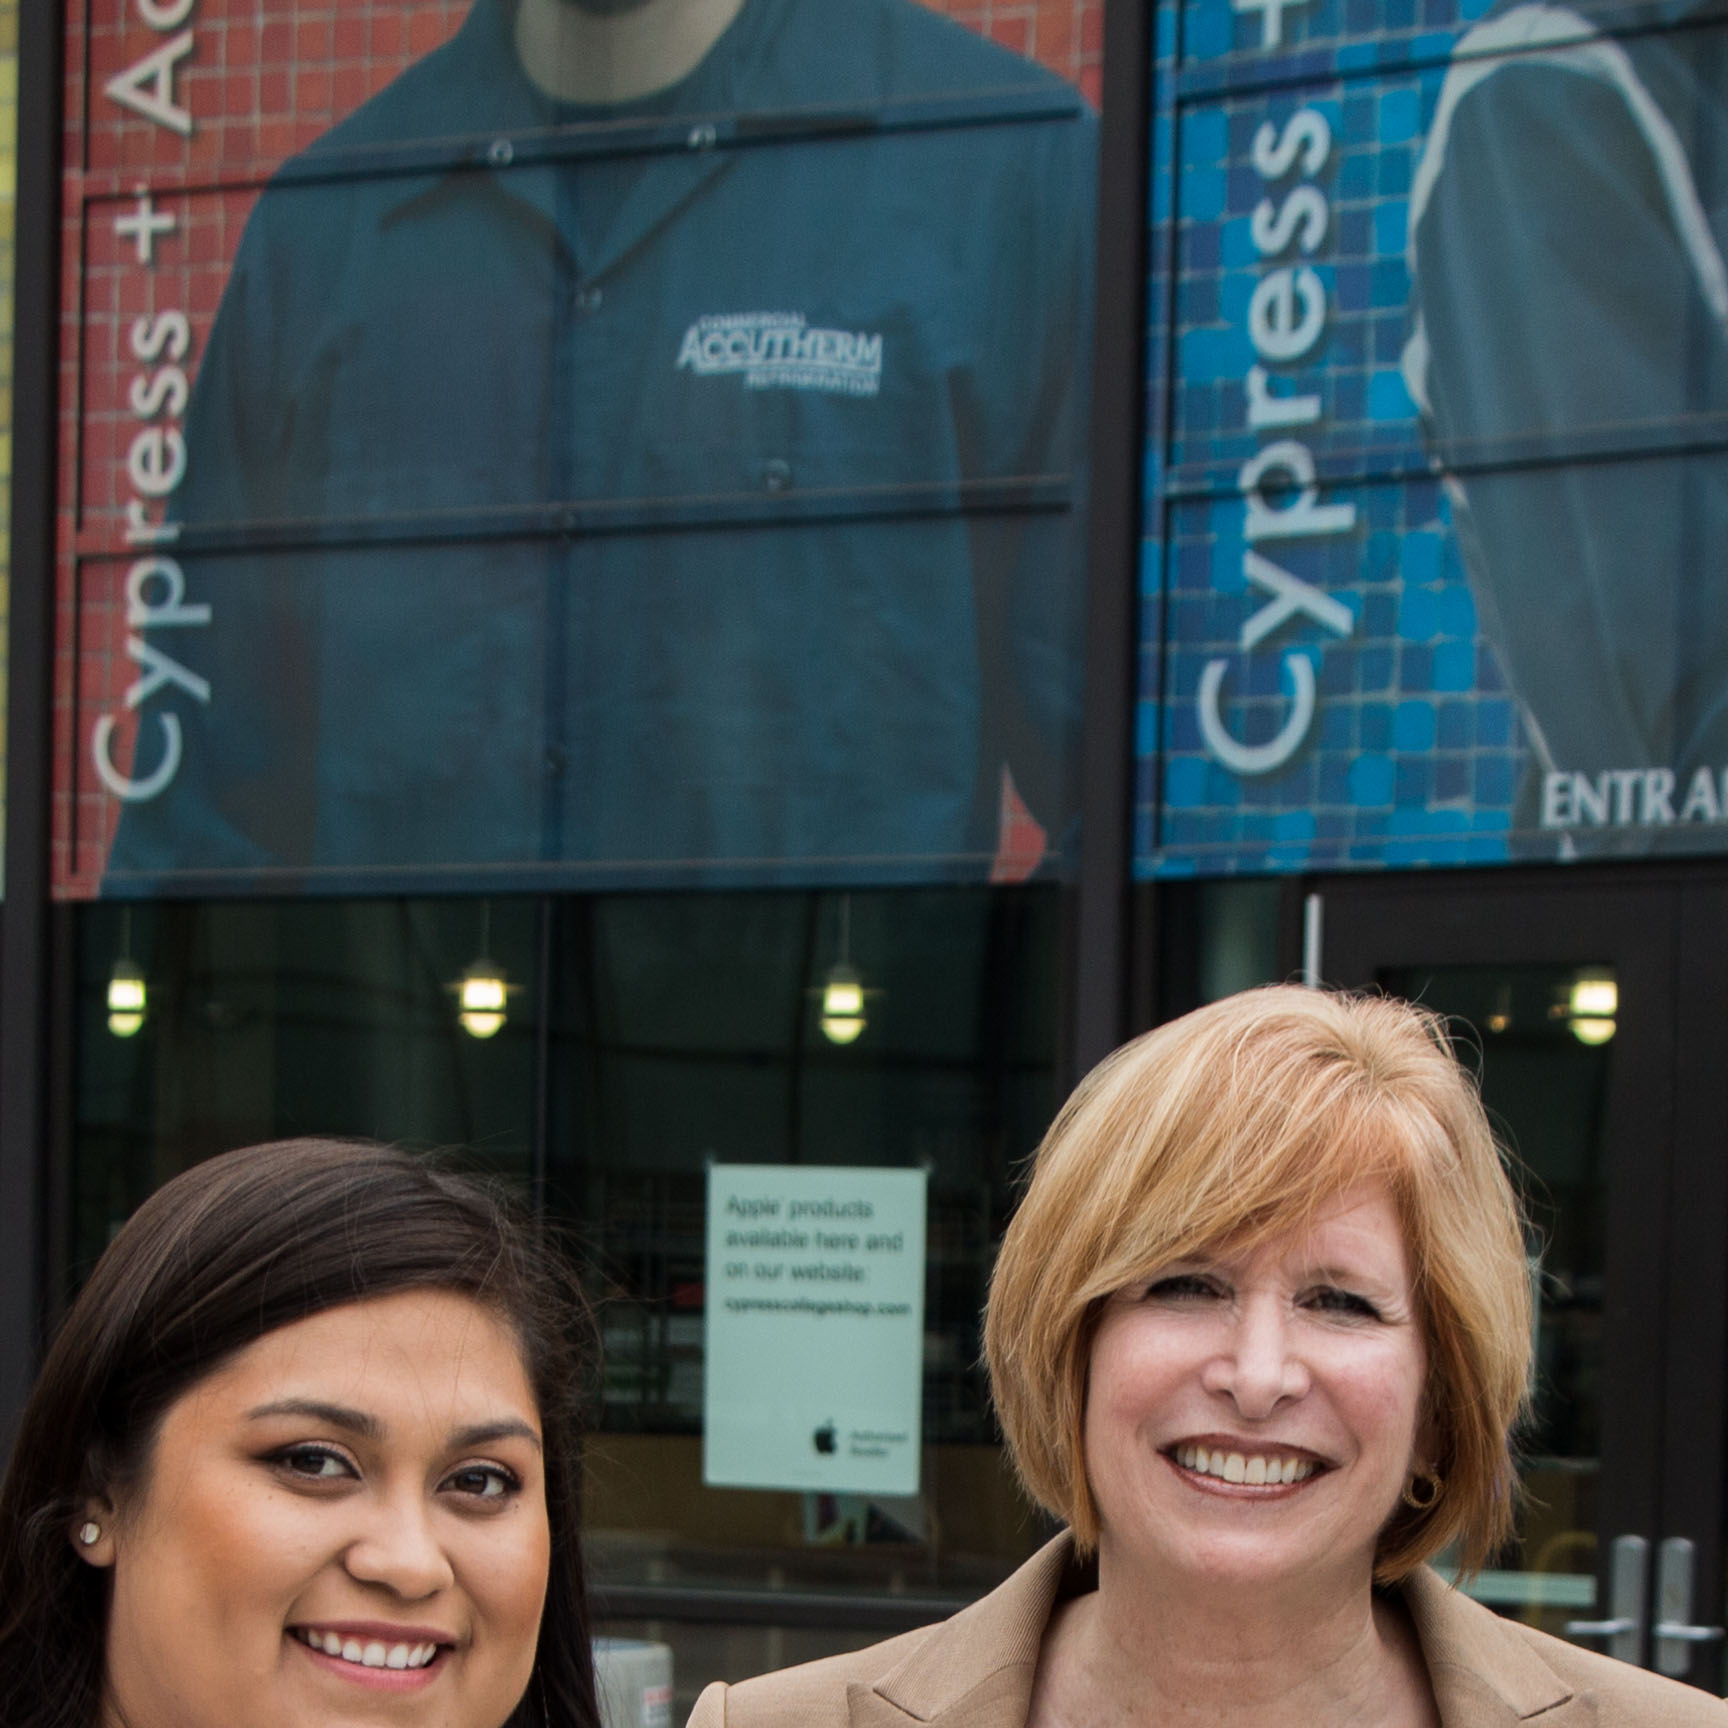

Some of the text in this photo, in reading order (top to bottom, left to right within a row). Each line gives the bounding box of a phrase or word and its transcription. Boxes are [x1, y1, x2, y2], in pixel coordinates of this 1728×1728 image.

[674, 324, 883, 376] ACCUTHERM
[1197, 108, 1355, 776] Cypress
[92, 310, 212, 800] Cypress
[789, 1198, 875, 1222] products
[726, 1229, 905, 1250] available here and
[725, 1262, 749, 1279] on
[754, 1263, 784, 1279] our
